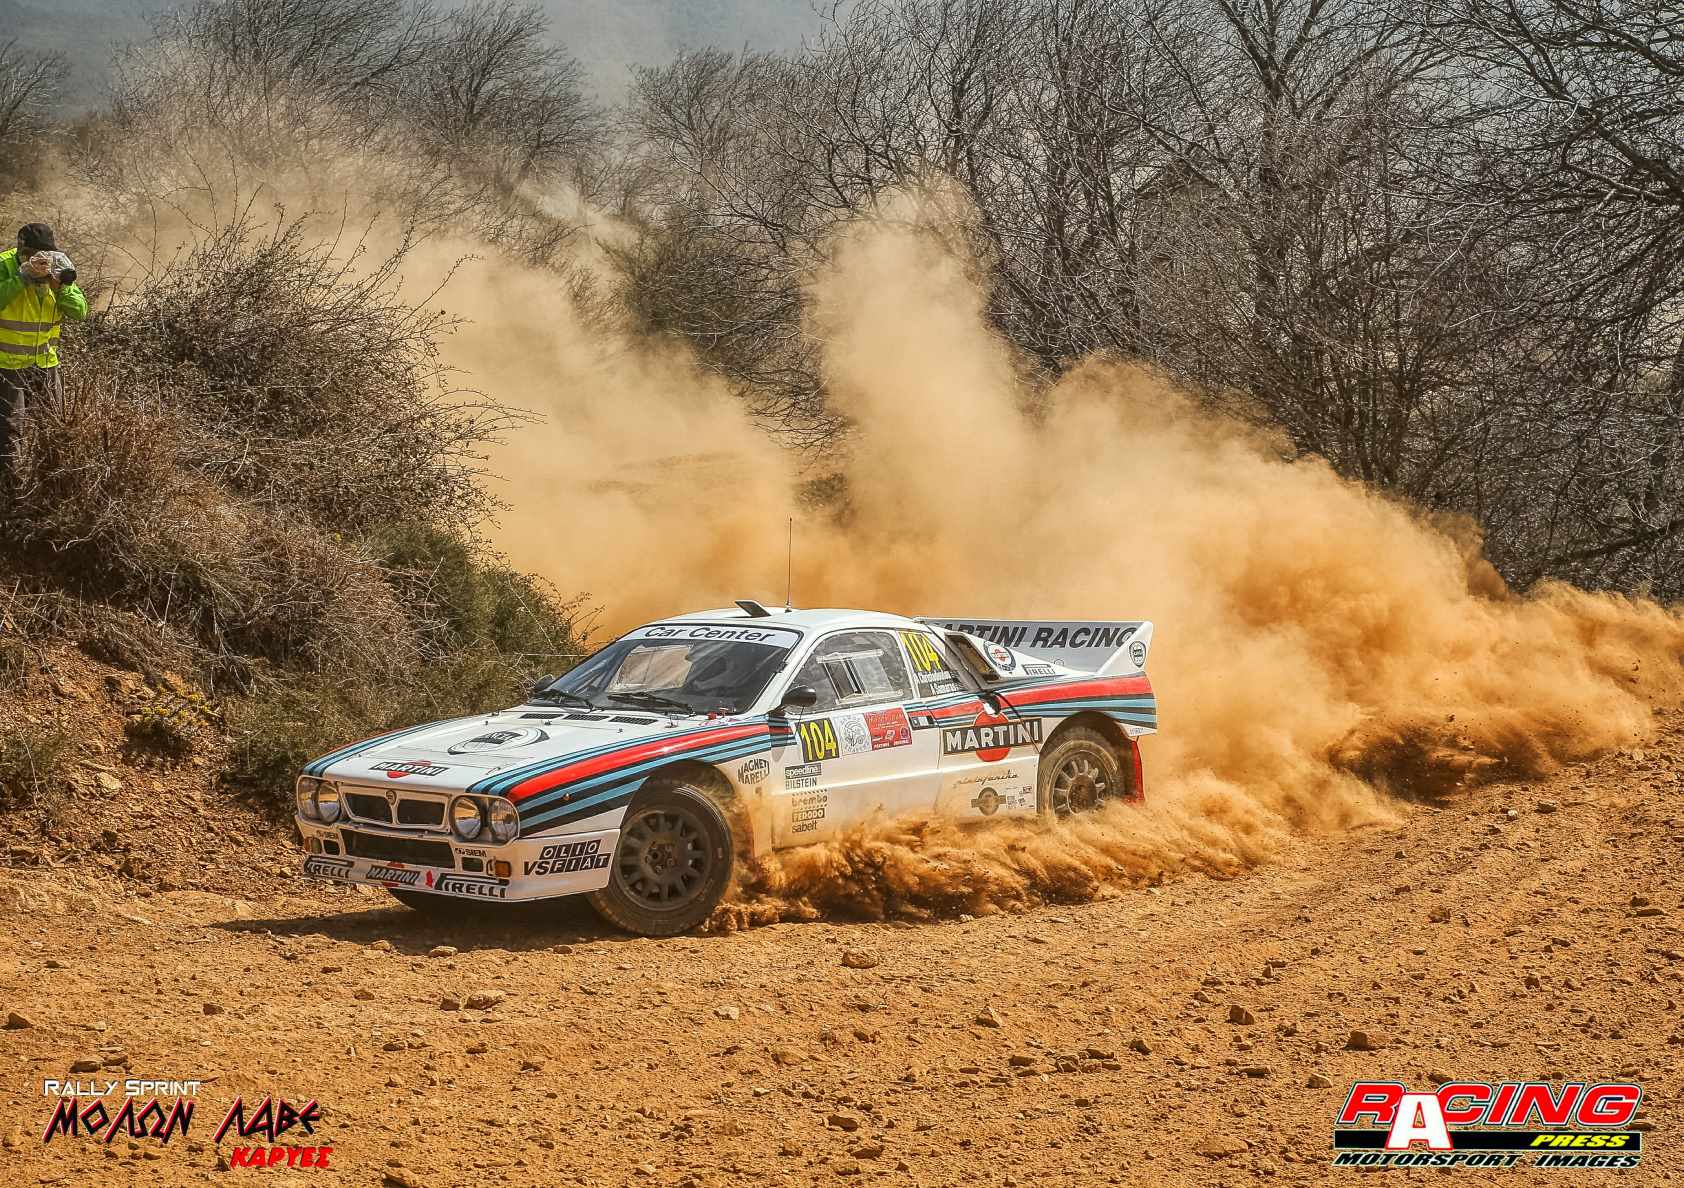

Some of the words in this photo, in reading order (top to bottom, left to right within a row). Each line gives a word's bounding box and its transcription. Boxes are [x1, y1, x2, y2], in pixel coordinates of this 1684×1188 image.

[645, 627, 687, 637] Car
[688, 627, 776, 641] Center
[801, 719, 838, 761] 104
[945, 720, 1040, 751] MARTINI
[373, 761, 447, 776] MARTINI
[785, 777, 817, 790] BILSTEIN
[792, 794, 828, 807] brembo
[792, 808, 825, 822] FERODO
[792, 820, 817, 833] sabelt
[542, 841, 598, 858] OLIO
[367, 865, 419, 886] MARTINI
